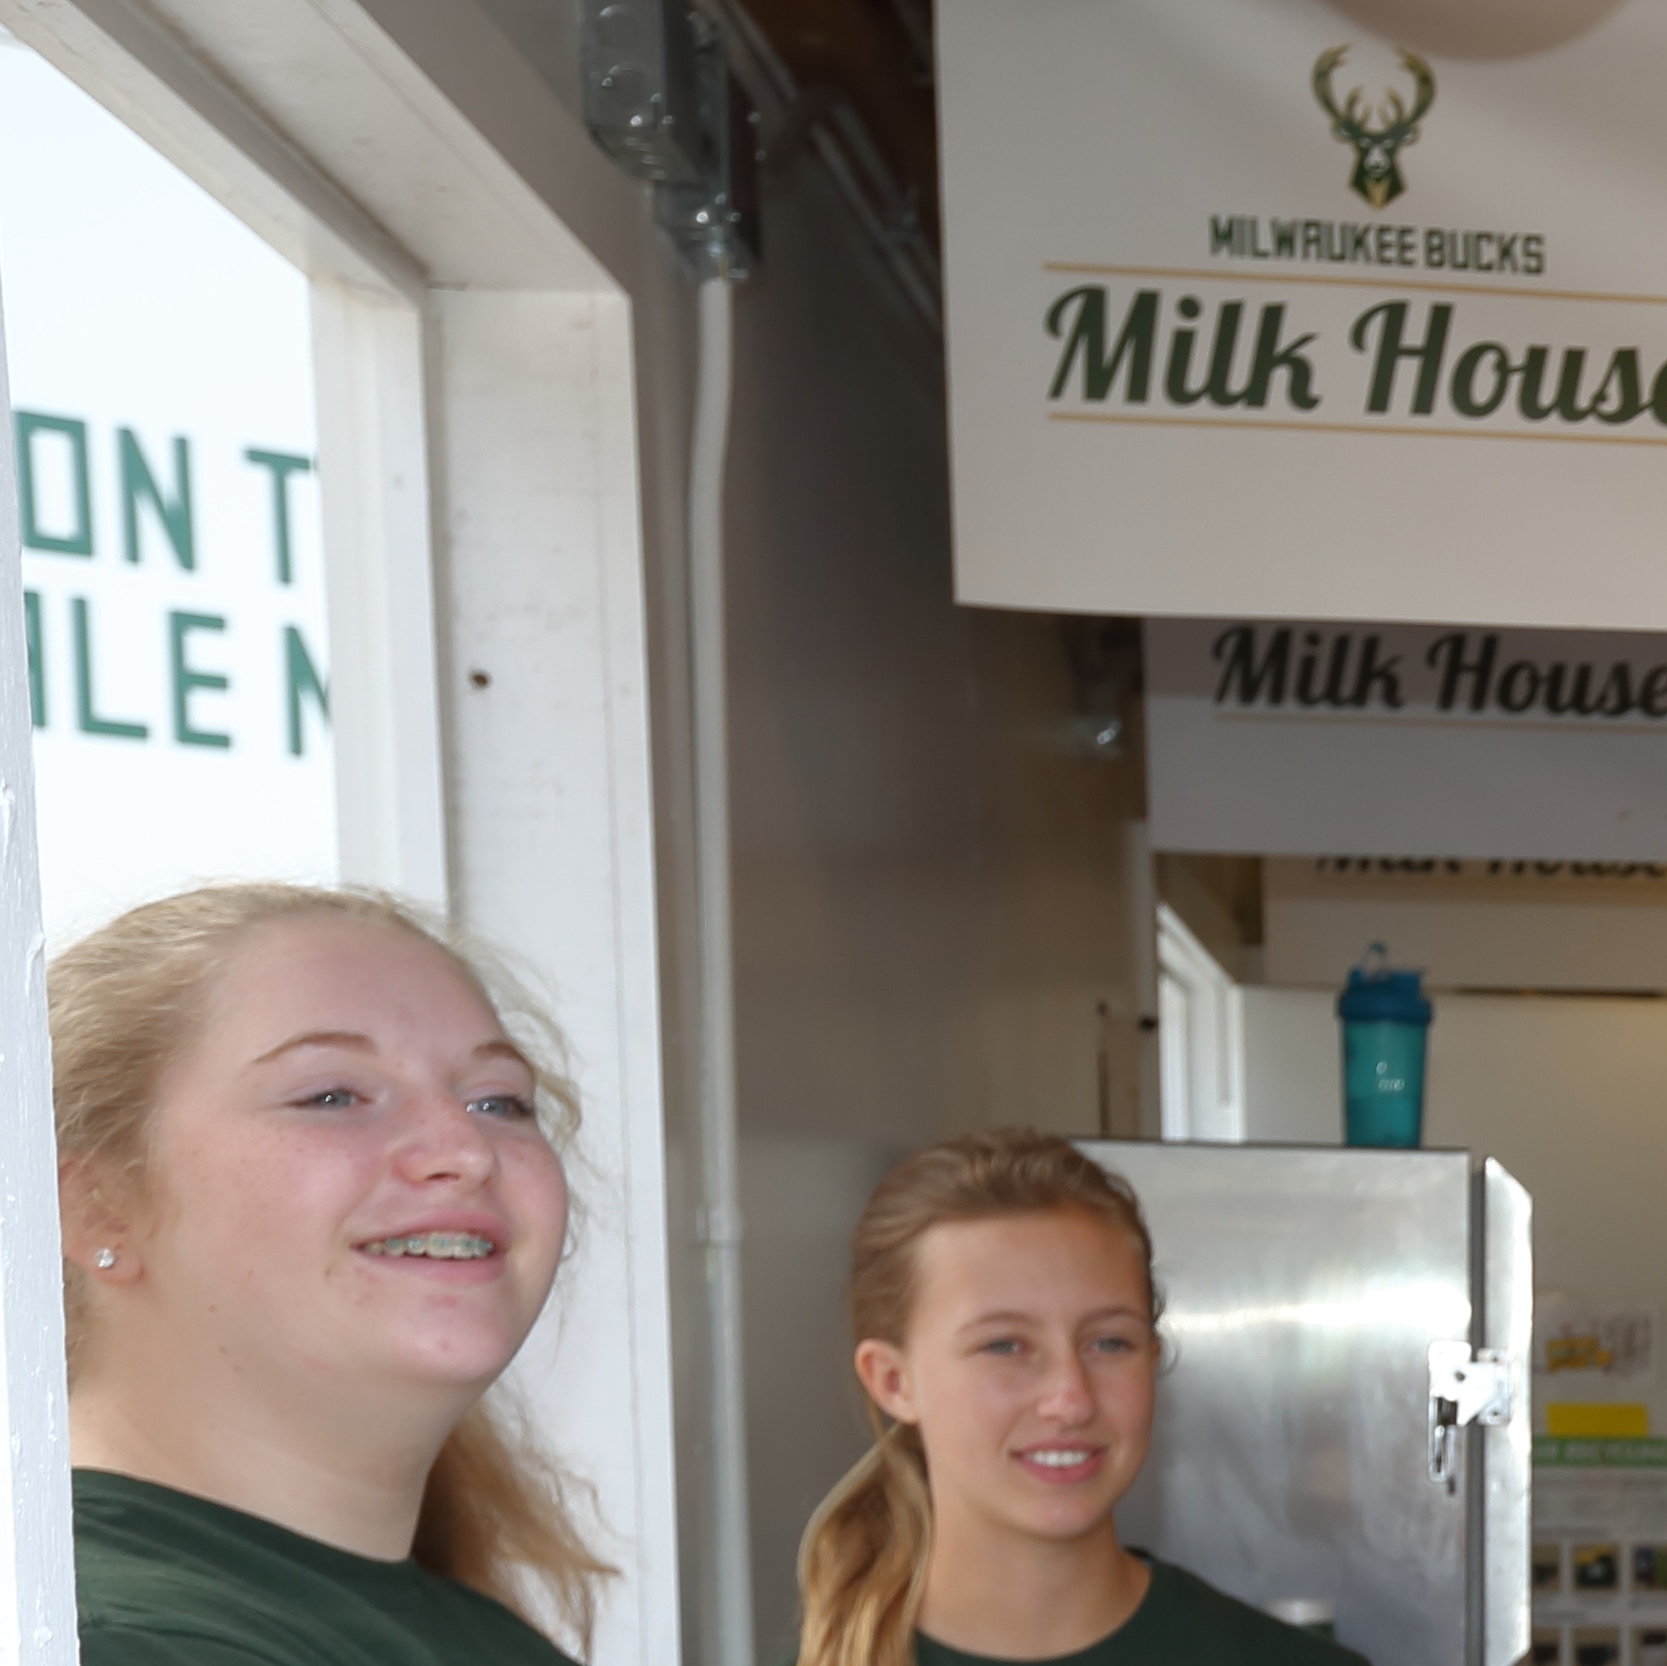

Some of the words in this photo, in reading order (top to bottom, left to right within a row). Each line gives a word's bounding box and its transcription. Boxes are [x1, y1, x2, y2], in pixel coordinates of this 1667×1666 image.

[1209, 216, 1417, 270] MILWAUKEE
[1426, 228, 1546, 276] BUCKS
[1044, 285, 1321, 414] Milk
[14, 410, 196, 573] ON
[1210, 624, 1408, 711] Milk
